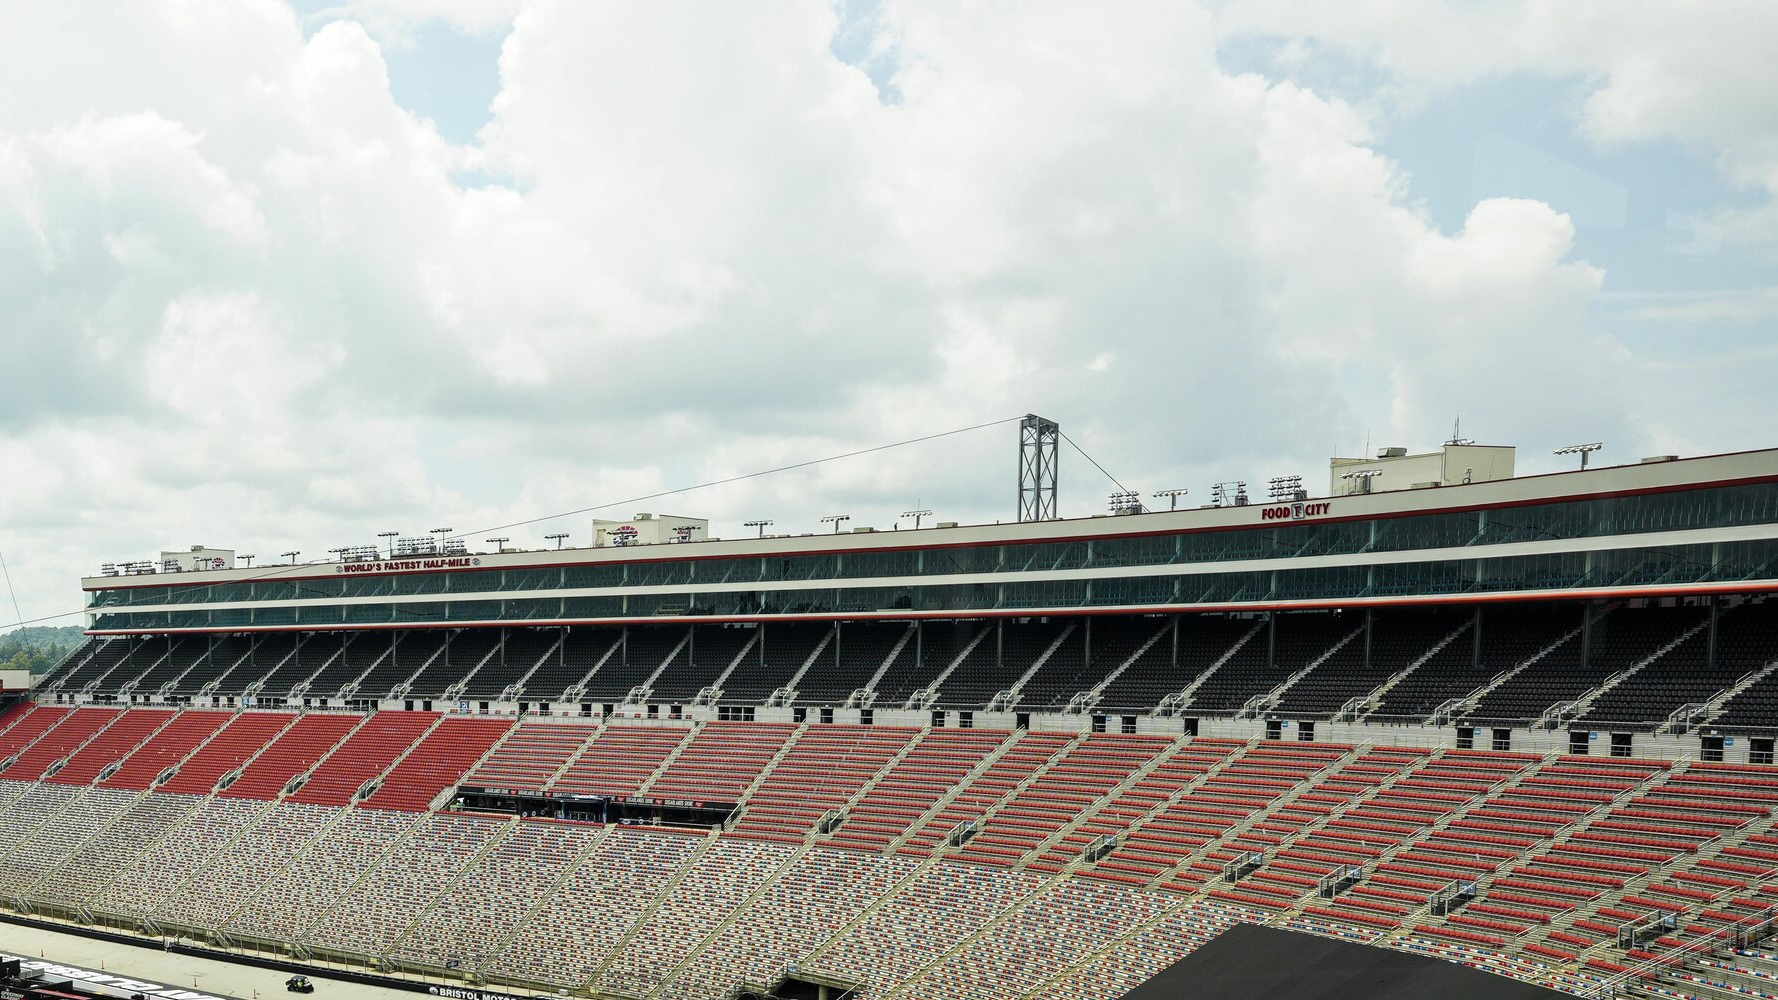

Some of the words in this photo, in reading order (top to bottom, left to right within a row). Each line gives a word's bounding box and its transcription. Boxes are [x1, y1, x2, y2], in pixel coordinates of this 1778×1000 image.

[1262, 507, 1290, 520] FOOD
[1305, 503, 1330, 516] CITY
[343, 563, 381, 573] WORLD'S
[384, 560, 421, 570] FASTEST
[423, 558, 470, 569] HALF-MILE
[439, 988, 480, 1000] BRISTOL
